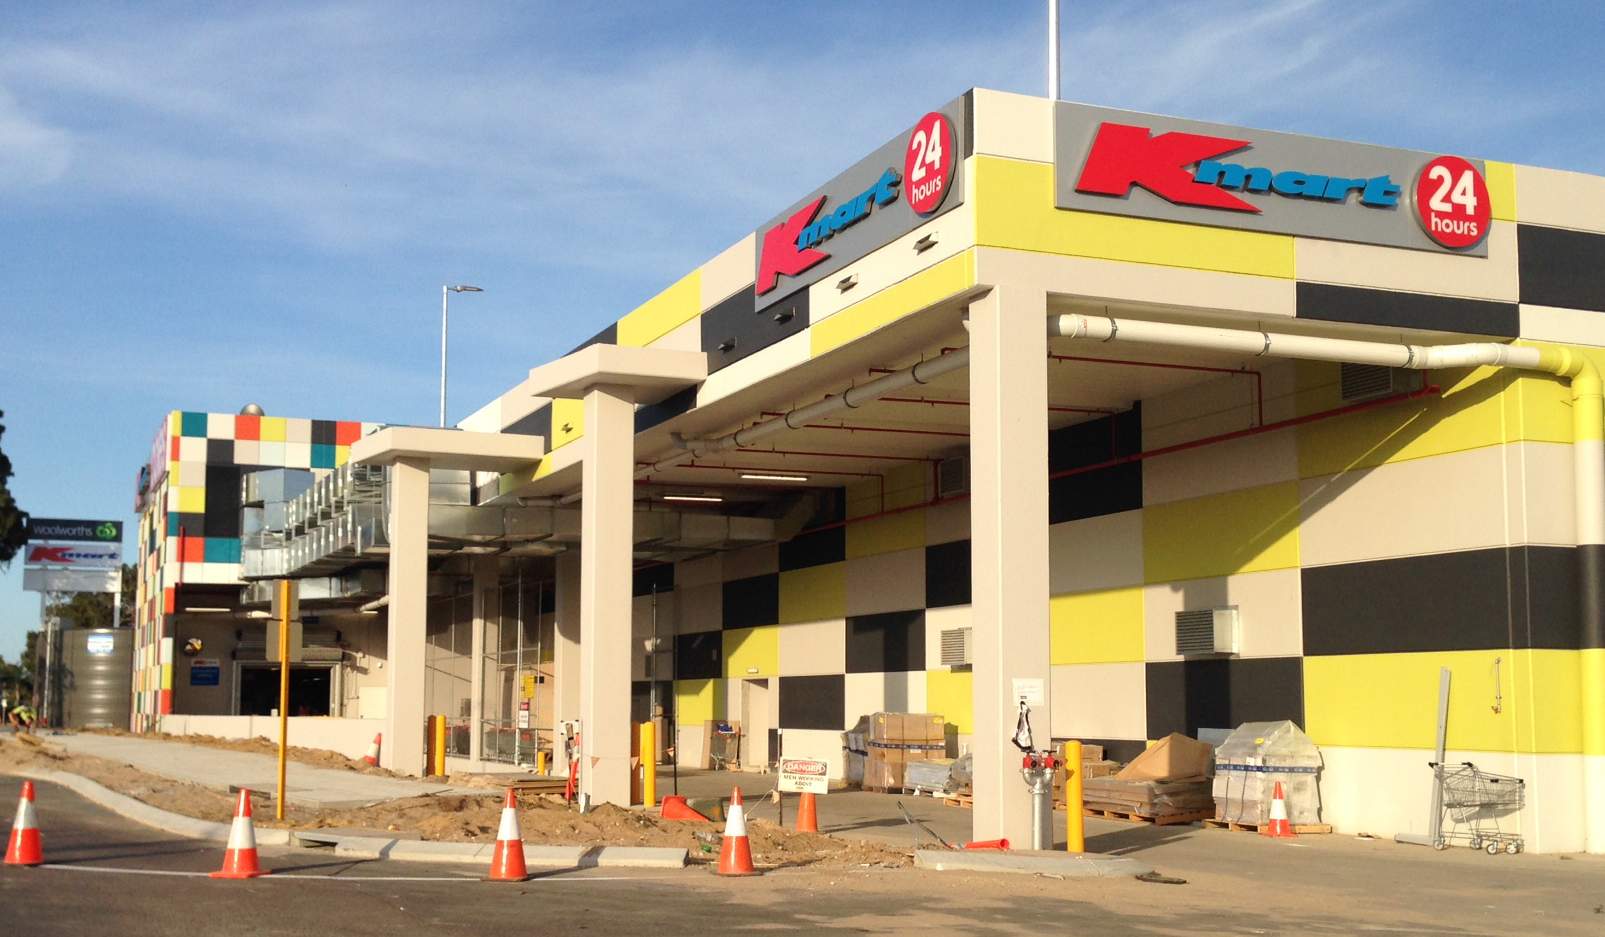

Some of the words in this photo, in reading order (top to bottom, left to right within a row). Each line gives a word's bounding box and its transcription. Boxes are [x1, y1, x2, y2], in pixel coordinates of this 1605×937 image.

[910, 119, 943, 183] 24
[1074, 121, 1401, 216] Kmart
[911, 174, 942, 204] hours
[1428, 164, 1478, 216] 24
[755, 166, 903, 296] Kmart
[1430, 211, 1479, 236] hours
[787, 762, 821, 772] DANGER
